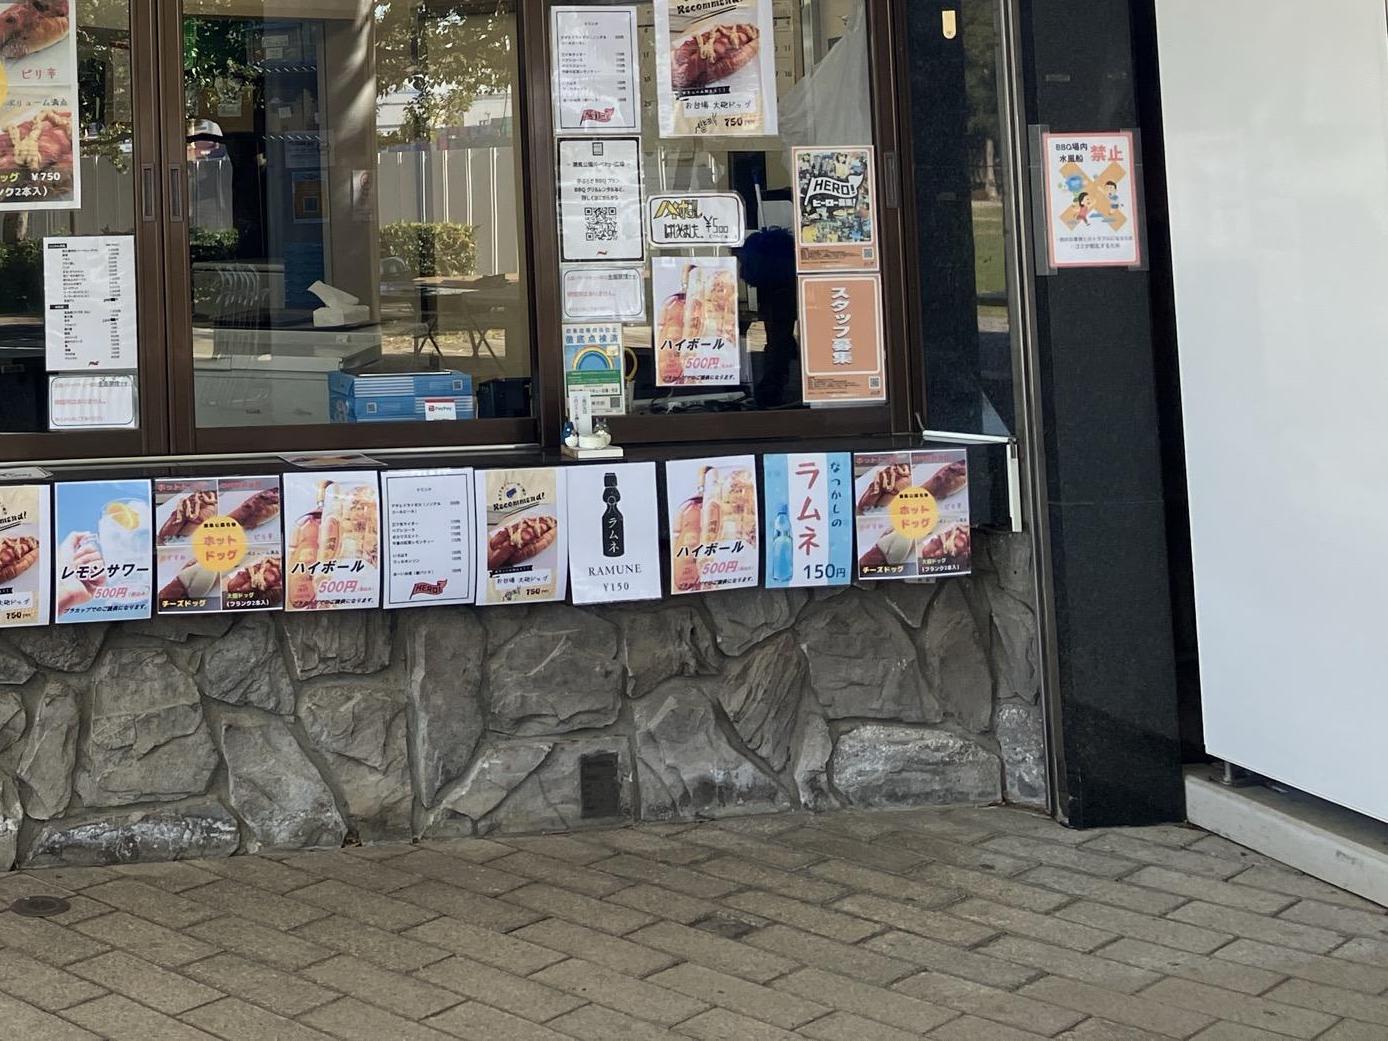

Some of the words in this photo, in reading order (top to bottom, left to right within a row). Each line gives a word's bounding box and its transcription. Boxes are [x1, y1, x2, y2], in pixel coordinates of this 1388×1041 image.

[724, 117, 743, 126] 750
[1090, 144, 1124, 162] 禁止
[31, 172, 61, 181] ¥750
[813, 179, 856, 196] HERO!
[660, 338, 725, 351] ハイボール
[685, 357, 720, 369] 500円
[830, 462, 842, 527] なつかしの
[493, 492, 545, 511] Recommend!
[795, 462, 821, 556] ラムネ
[900, 505, 930, 515] ホット
[901, 518, 931, 529] ドッグ
[204, 534, 237, 545] ホット
[608, 517, 619, 553] ラムネ
[206, 549, 238, 561] ドッグ
[676, 540, 744, 558] ハイボール
[61, 563, 149, 580] レモンサワー
[291, 560, 364, 575] ハイボール
[588, 564, 642, 576] RAMUNE
[702, 560, 739, 575] 500円
[803, 563, 846, 579] 150円
[862, 565, 904, 573] チーズドッグ
[95, 586, 128, 599] 500円
[319, 580, 358, 593] 500円
[162, 599, 207, 608] チーズドッグ
[6, 611, 22, 619] 750
